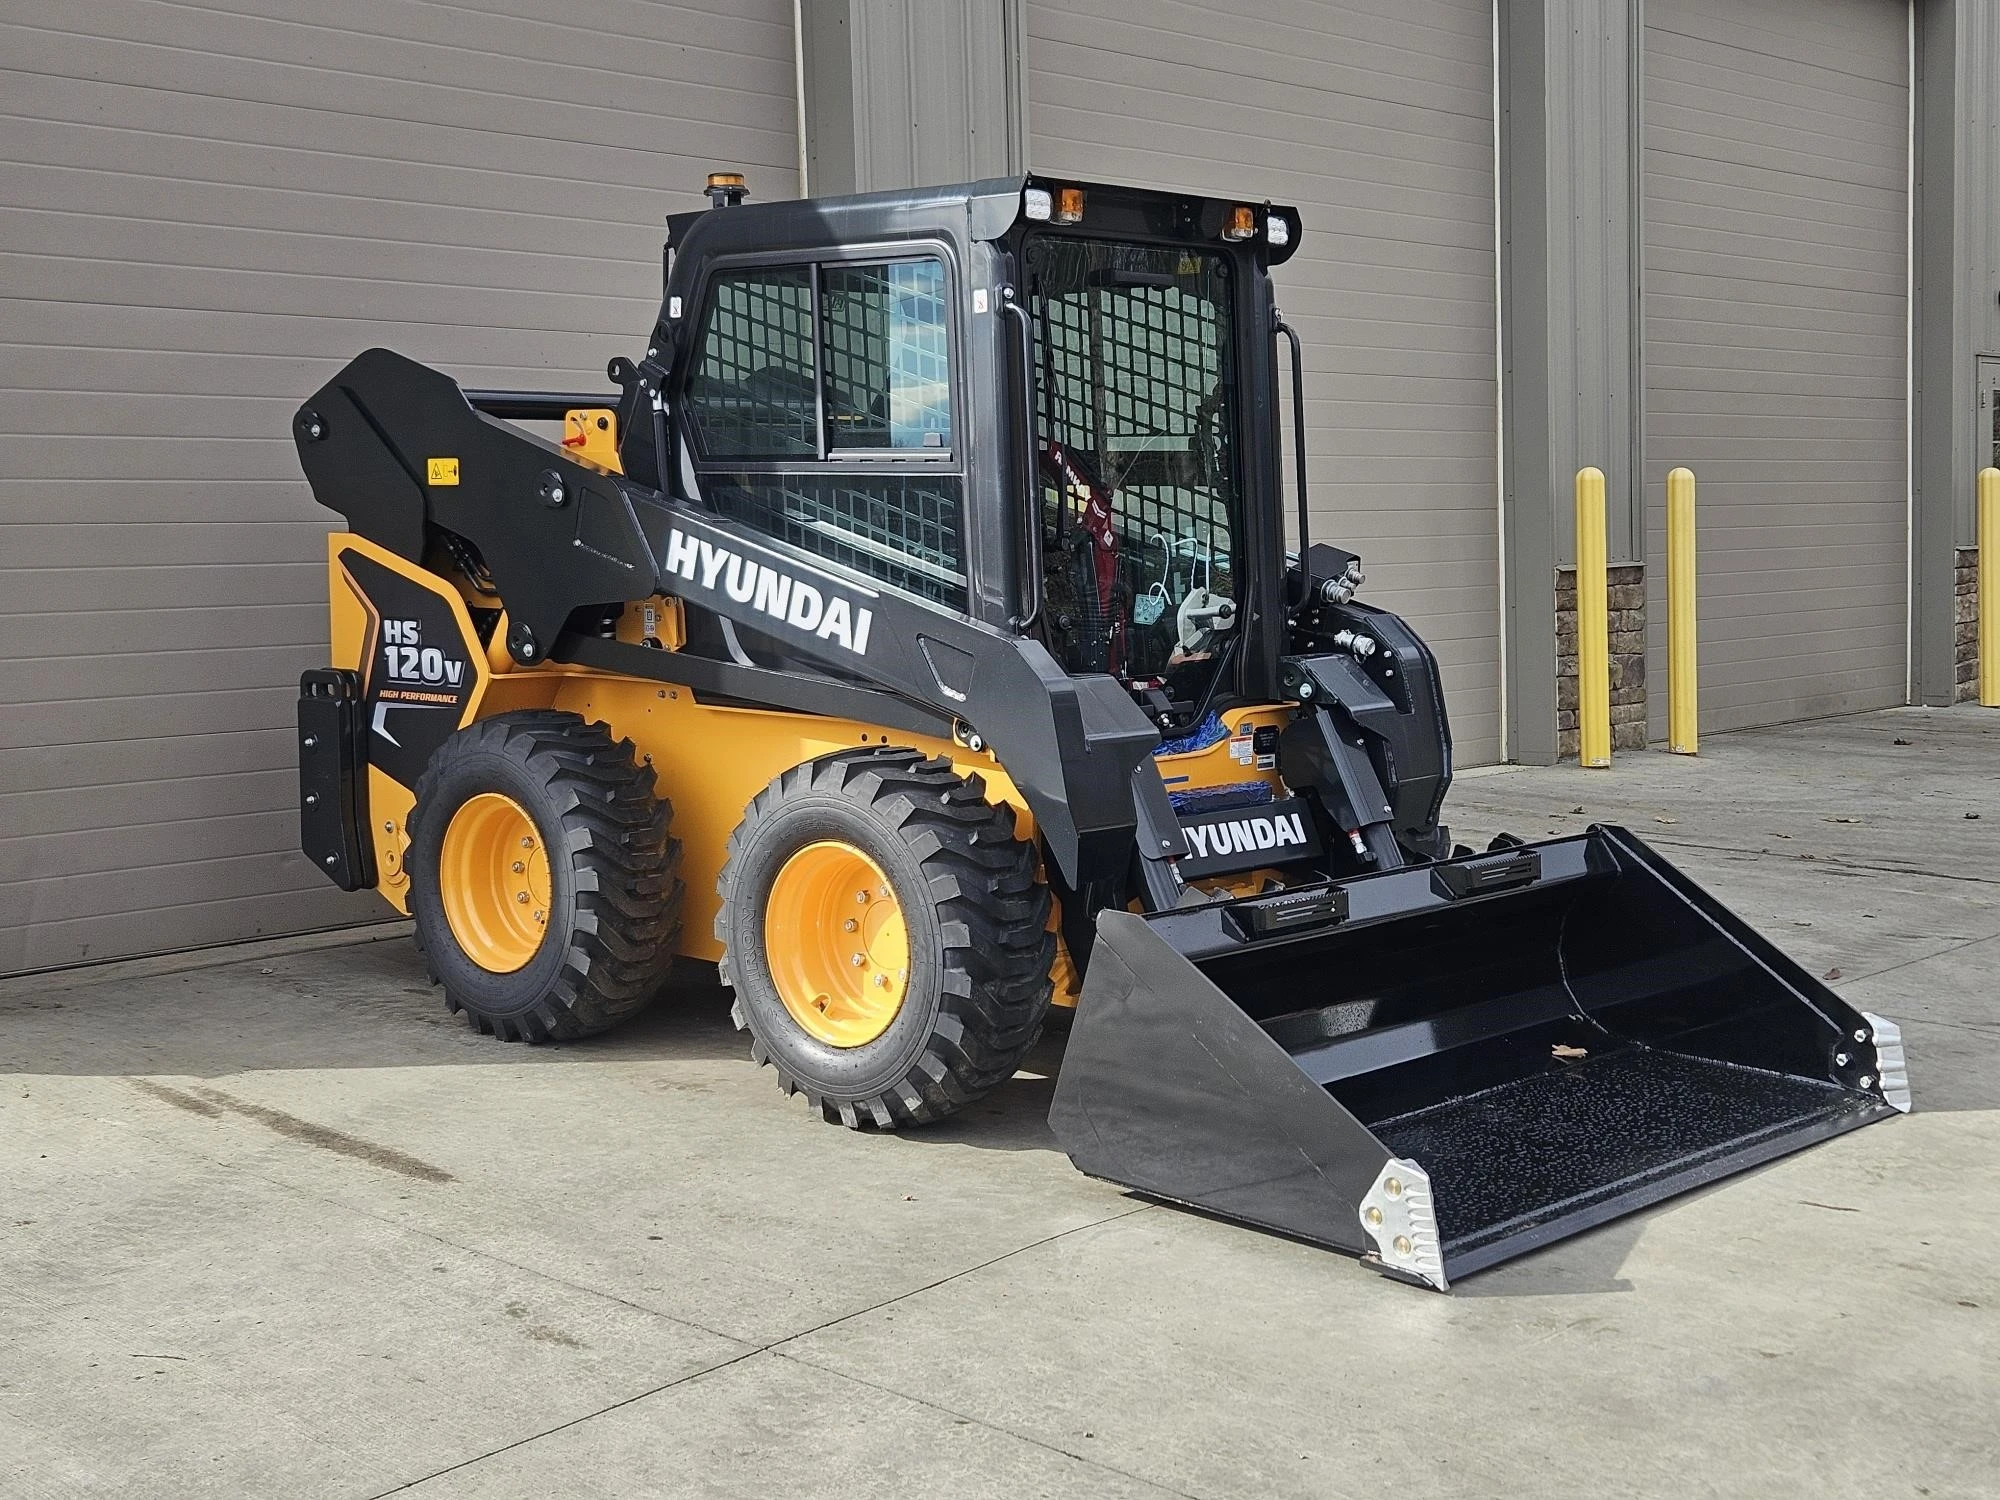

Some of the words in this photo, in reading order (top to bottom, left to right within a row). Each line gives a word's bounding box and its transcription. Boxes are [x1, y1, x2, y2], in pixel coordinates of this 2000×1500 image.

[665, 528, 873, 656] HYUNDAI
[384, 620, 419, 645] HS
[379, 689, 399, 699] HIGH
[400, 691, 459, 704] PERFORMANCE
